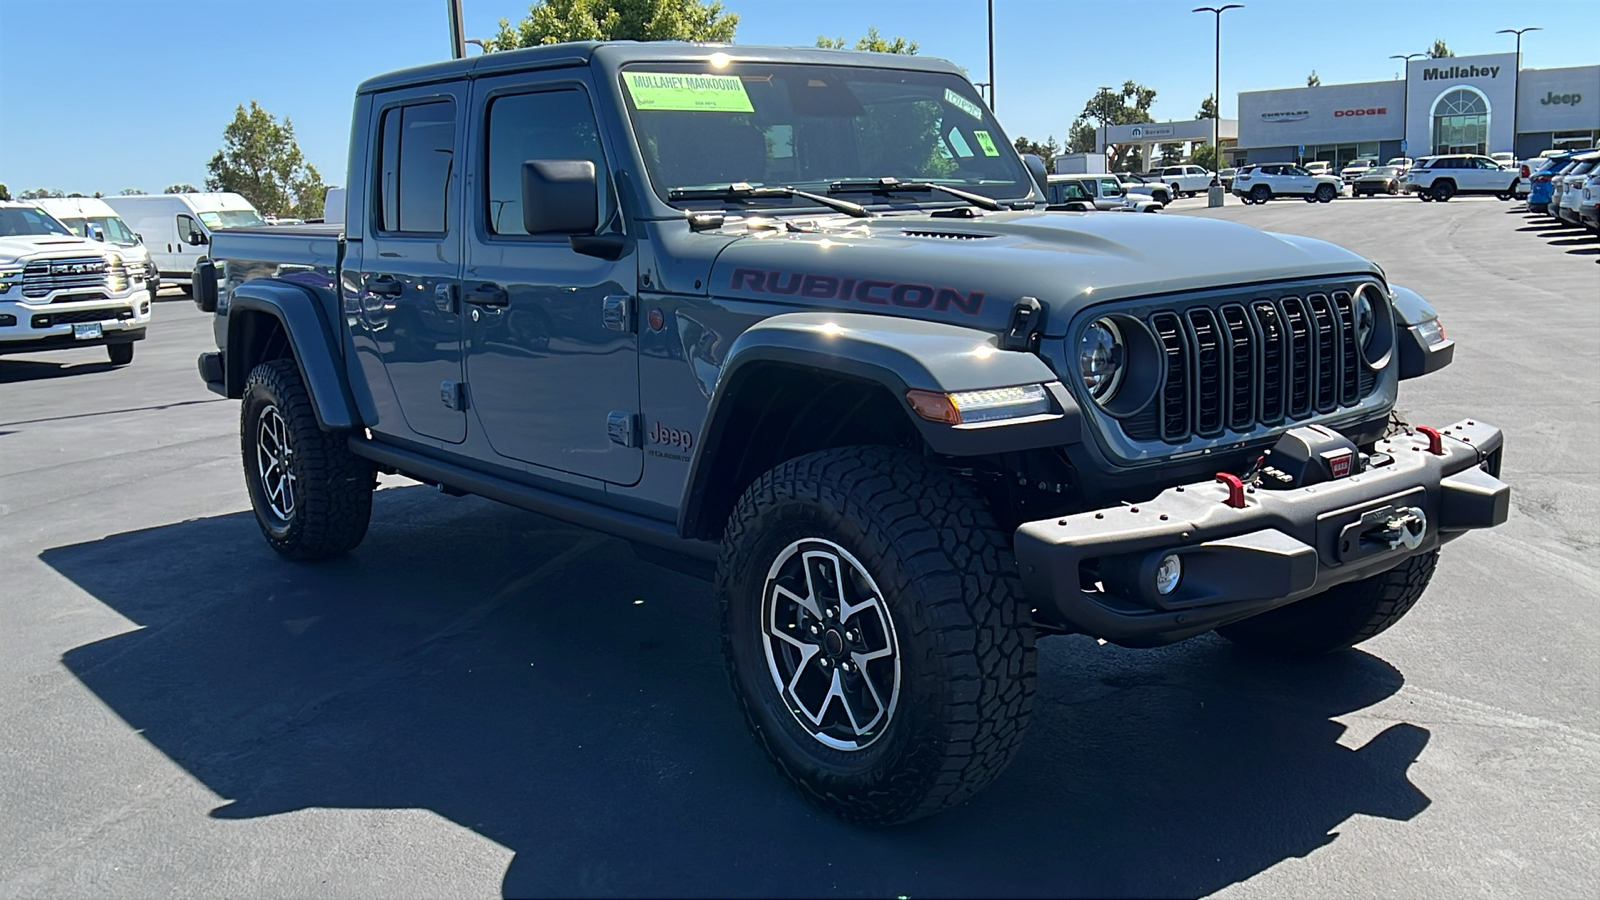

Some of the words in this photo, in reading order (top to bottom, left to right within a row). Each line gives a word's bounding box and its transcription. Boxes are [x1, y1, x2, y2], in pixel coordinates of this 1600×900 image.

[1423, 65, 1500, 81] Mullahey
[633, 75, 684, 89] MULLAHEY
[685, 76, 741, 91] MARKDOWN
[1540, 91, 1582, 106] Jeep
[1261, 110, 1309, 118] CHRYSLER
[1334, 107, 1387, 118] DODGE
[731, 267, 986, 316] RUBICON
[648, 421, 693, 453] Jeep
